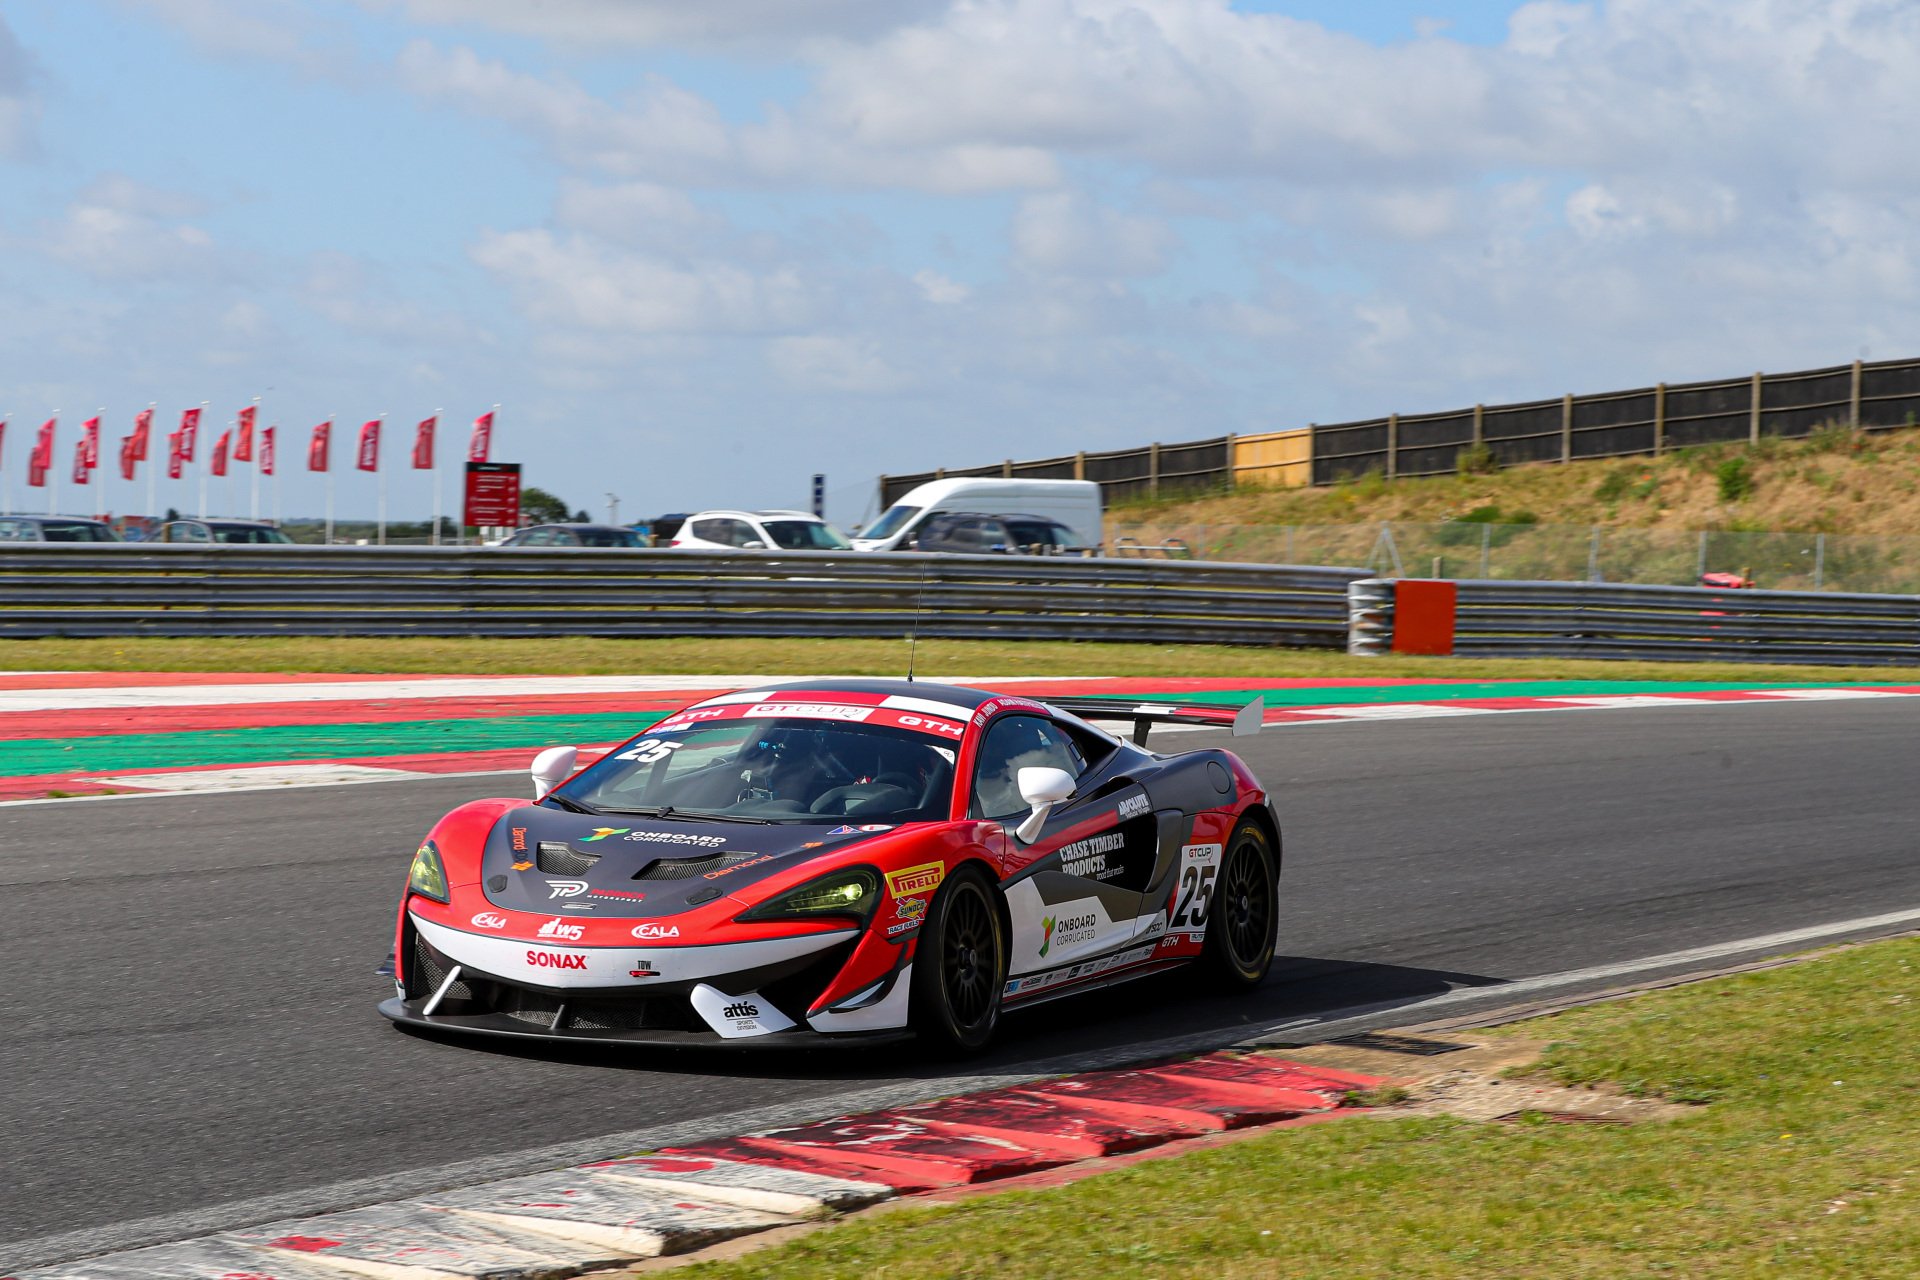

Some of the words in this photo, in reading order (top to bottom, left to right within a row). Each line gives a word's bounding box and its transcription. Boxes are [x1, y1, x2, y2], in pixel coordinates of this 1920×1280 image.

[898, 716, 965, 736] GTH
[614, 739, 685, 762] 25
[623, 836, 720, 848] CORRUGATED
[631, 831, 727, 843] ONBOARD
[1059, 841, 1090, 862] CHASE
[1089, 832, 1125, 855] TIMBER
[703, 855, 774, 880] Diamond
[1062, 855, 1106, 877] PRODUCTS
[891, 867, 941, 893] PIRELLI
[1171, 866, 1216, 927] 25
[899, 902, 926, 915] SUNOCO
[472, 912, 507, 929] CALA
[888, 925, 904, 934] RACE
[1058, 914, 1096, 933] ONBOARD
[632, 923, 680, 939] CALA
[1057, 928, 1096, 946] CORRUGATED
[1162, 936, 1180, 947] GTH
[527, 951, 588, 969] SONAX
[637, 960, 652, 970] TOW
[723, 1001, 759, 1018] attis
